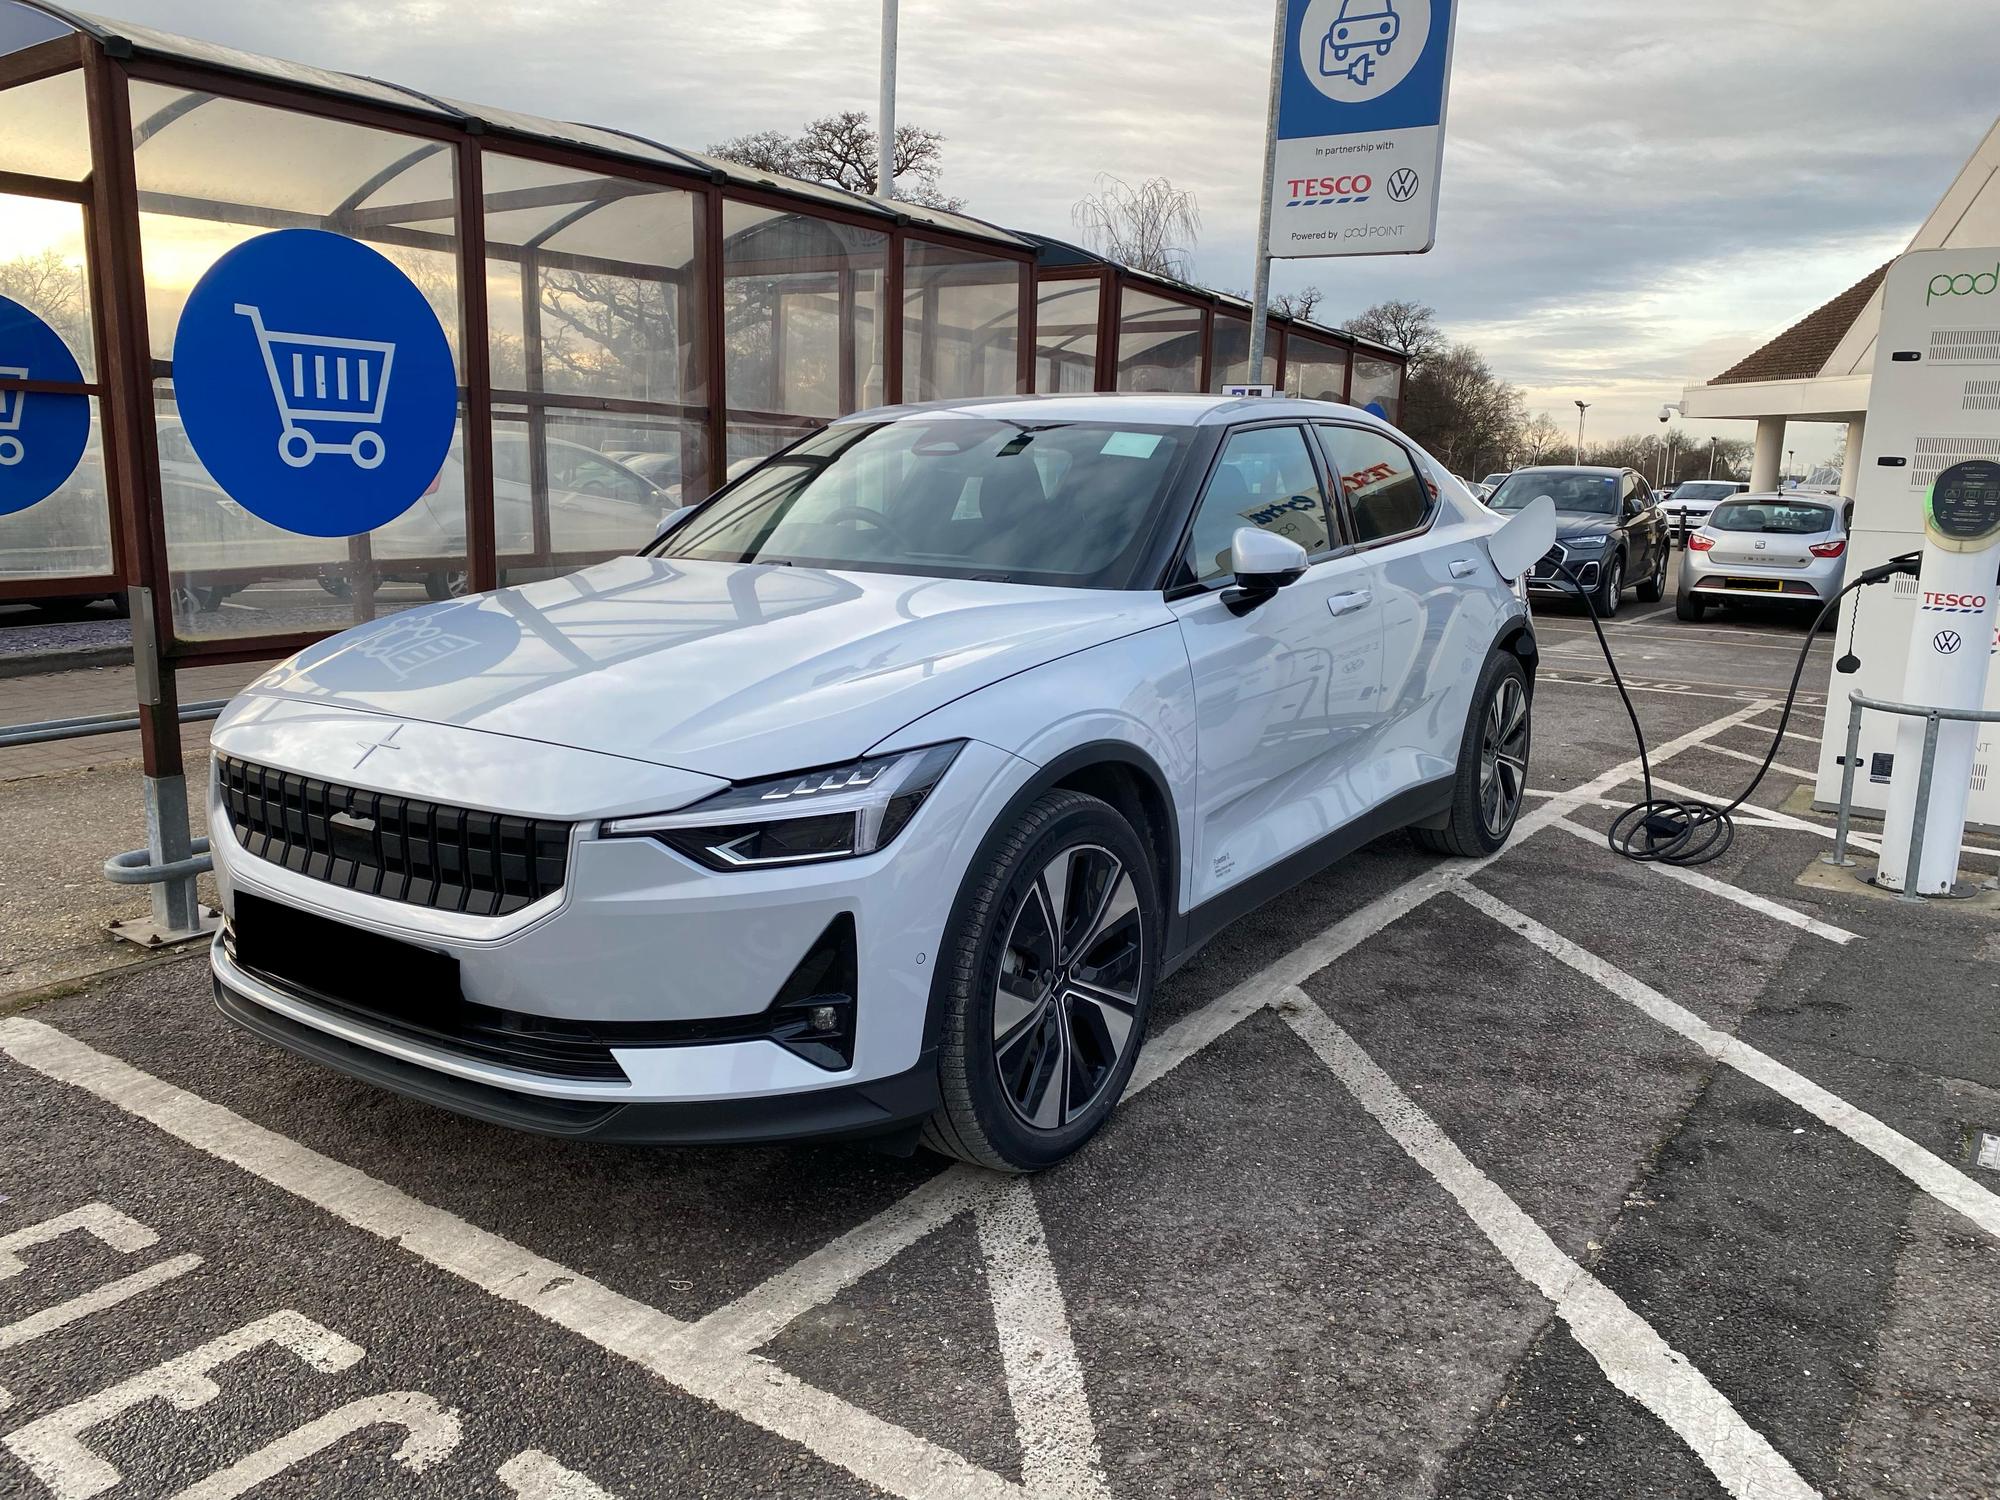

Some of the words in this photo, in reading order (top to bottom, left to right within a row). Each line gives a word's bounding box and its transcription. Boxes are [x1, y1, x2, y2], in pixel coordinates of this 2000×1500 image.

[1316, 147, 1323, 156] In
[1325, 143, 1374, 157] partnership
[1376, 141, 1394, 151] with
[1288, 174, 1372, 198] TESCO
[1291, 231, 1326, 241] Powered
[1328, 230, 1338, 240] by
[1926, 261, 2000, 307] pod
[1923, 592, 1986, 608] TESCO
